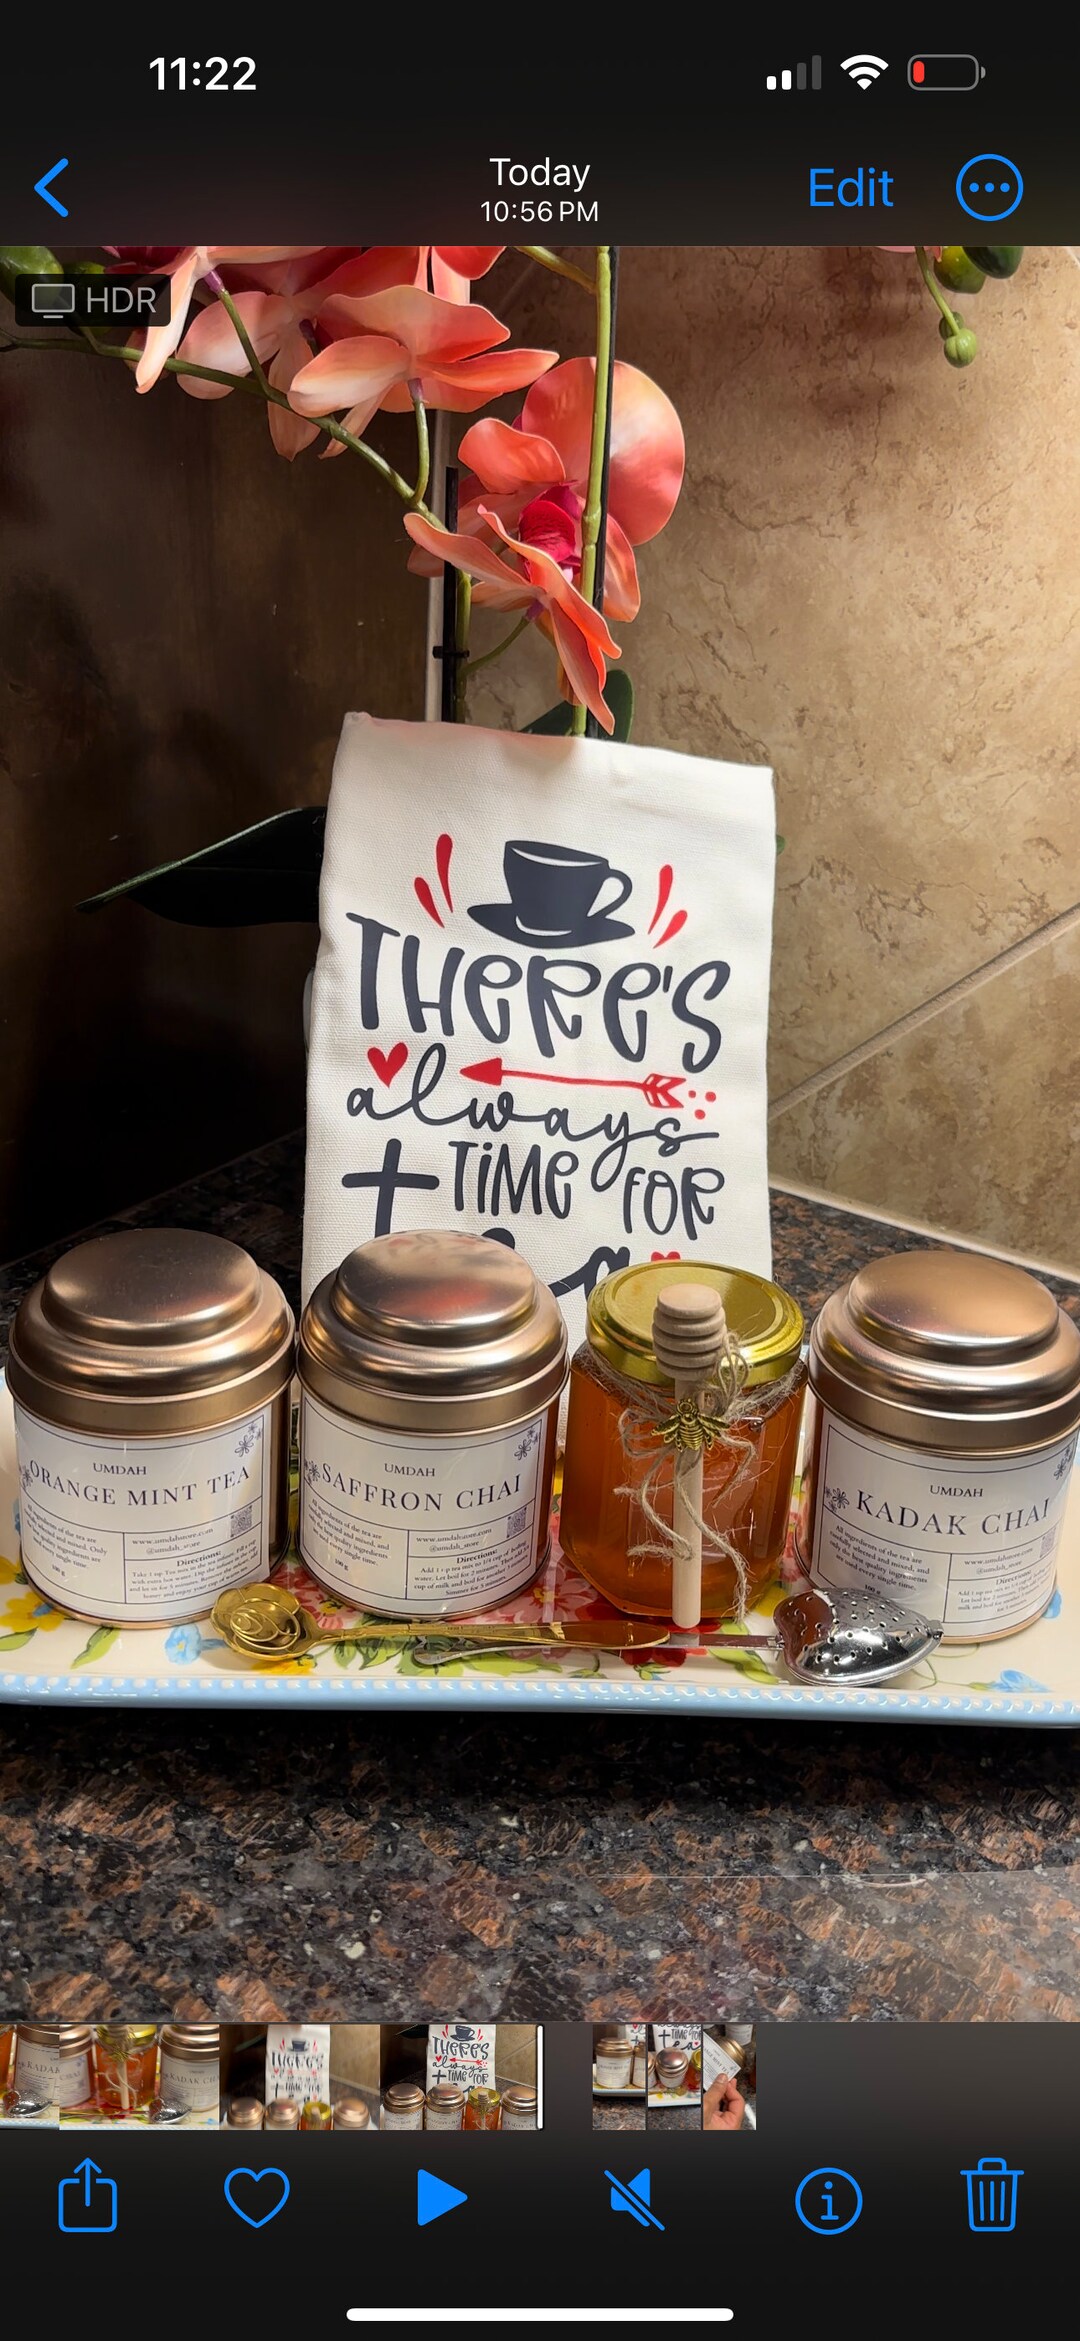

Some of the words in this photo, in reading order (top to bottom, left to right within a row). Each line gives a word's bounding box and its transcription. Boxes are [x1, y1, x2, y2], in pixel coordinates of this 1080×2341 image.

[150, 57, 256, 90] 11:22
[490, 157, 590, 192] Today
[811, 168, 893, 206] Edit
[481, 201, 552, 222] 10:56
[560, 201, 598, 221] PM
[87, 288, 157, 313] HDR
[345, 1041, 720, 1192] always
[623, 1165, 726, 1241] FOR
[92, 1462, 147, 1476] UMDAH
[384, 1463, 436, 1478] UMDAH
[29, 1458, 117, 1505] ORANGE
[127, 1484, 198, 1506] MINT
[207, 1465, 250, 1495] TEA
[322, 1462, 443, 1512] SAFFRON
[456, 1474, 522, 1510] CHAI
[929, 1484, 984, 1498] UMDAH
[856, 1489, 967, 1536] KADAK
[981, 1498, 1050, 1536] CHAI
[89, 1545, 108, 1557] Only
[177, 1550, 221, 1567] Directions:
[353, 1544, 388, 1559] ingredients
[456, 1549, 498, 1564] Directions:
[853, 1546, 876, 1560] selected
[916, 1567, 930, 1575] and
[887, 1550, 898, 1558] the
[858, 1567, 875, 1579] every
[877, 1575, 897, 1585] single
[865, 1561, 886, 1575] quality
[865, 1584, 876, 1592] 100
